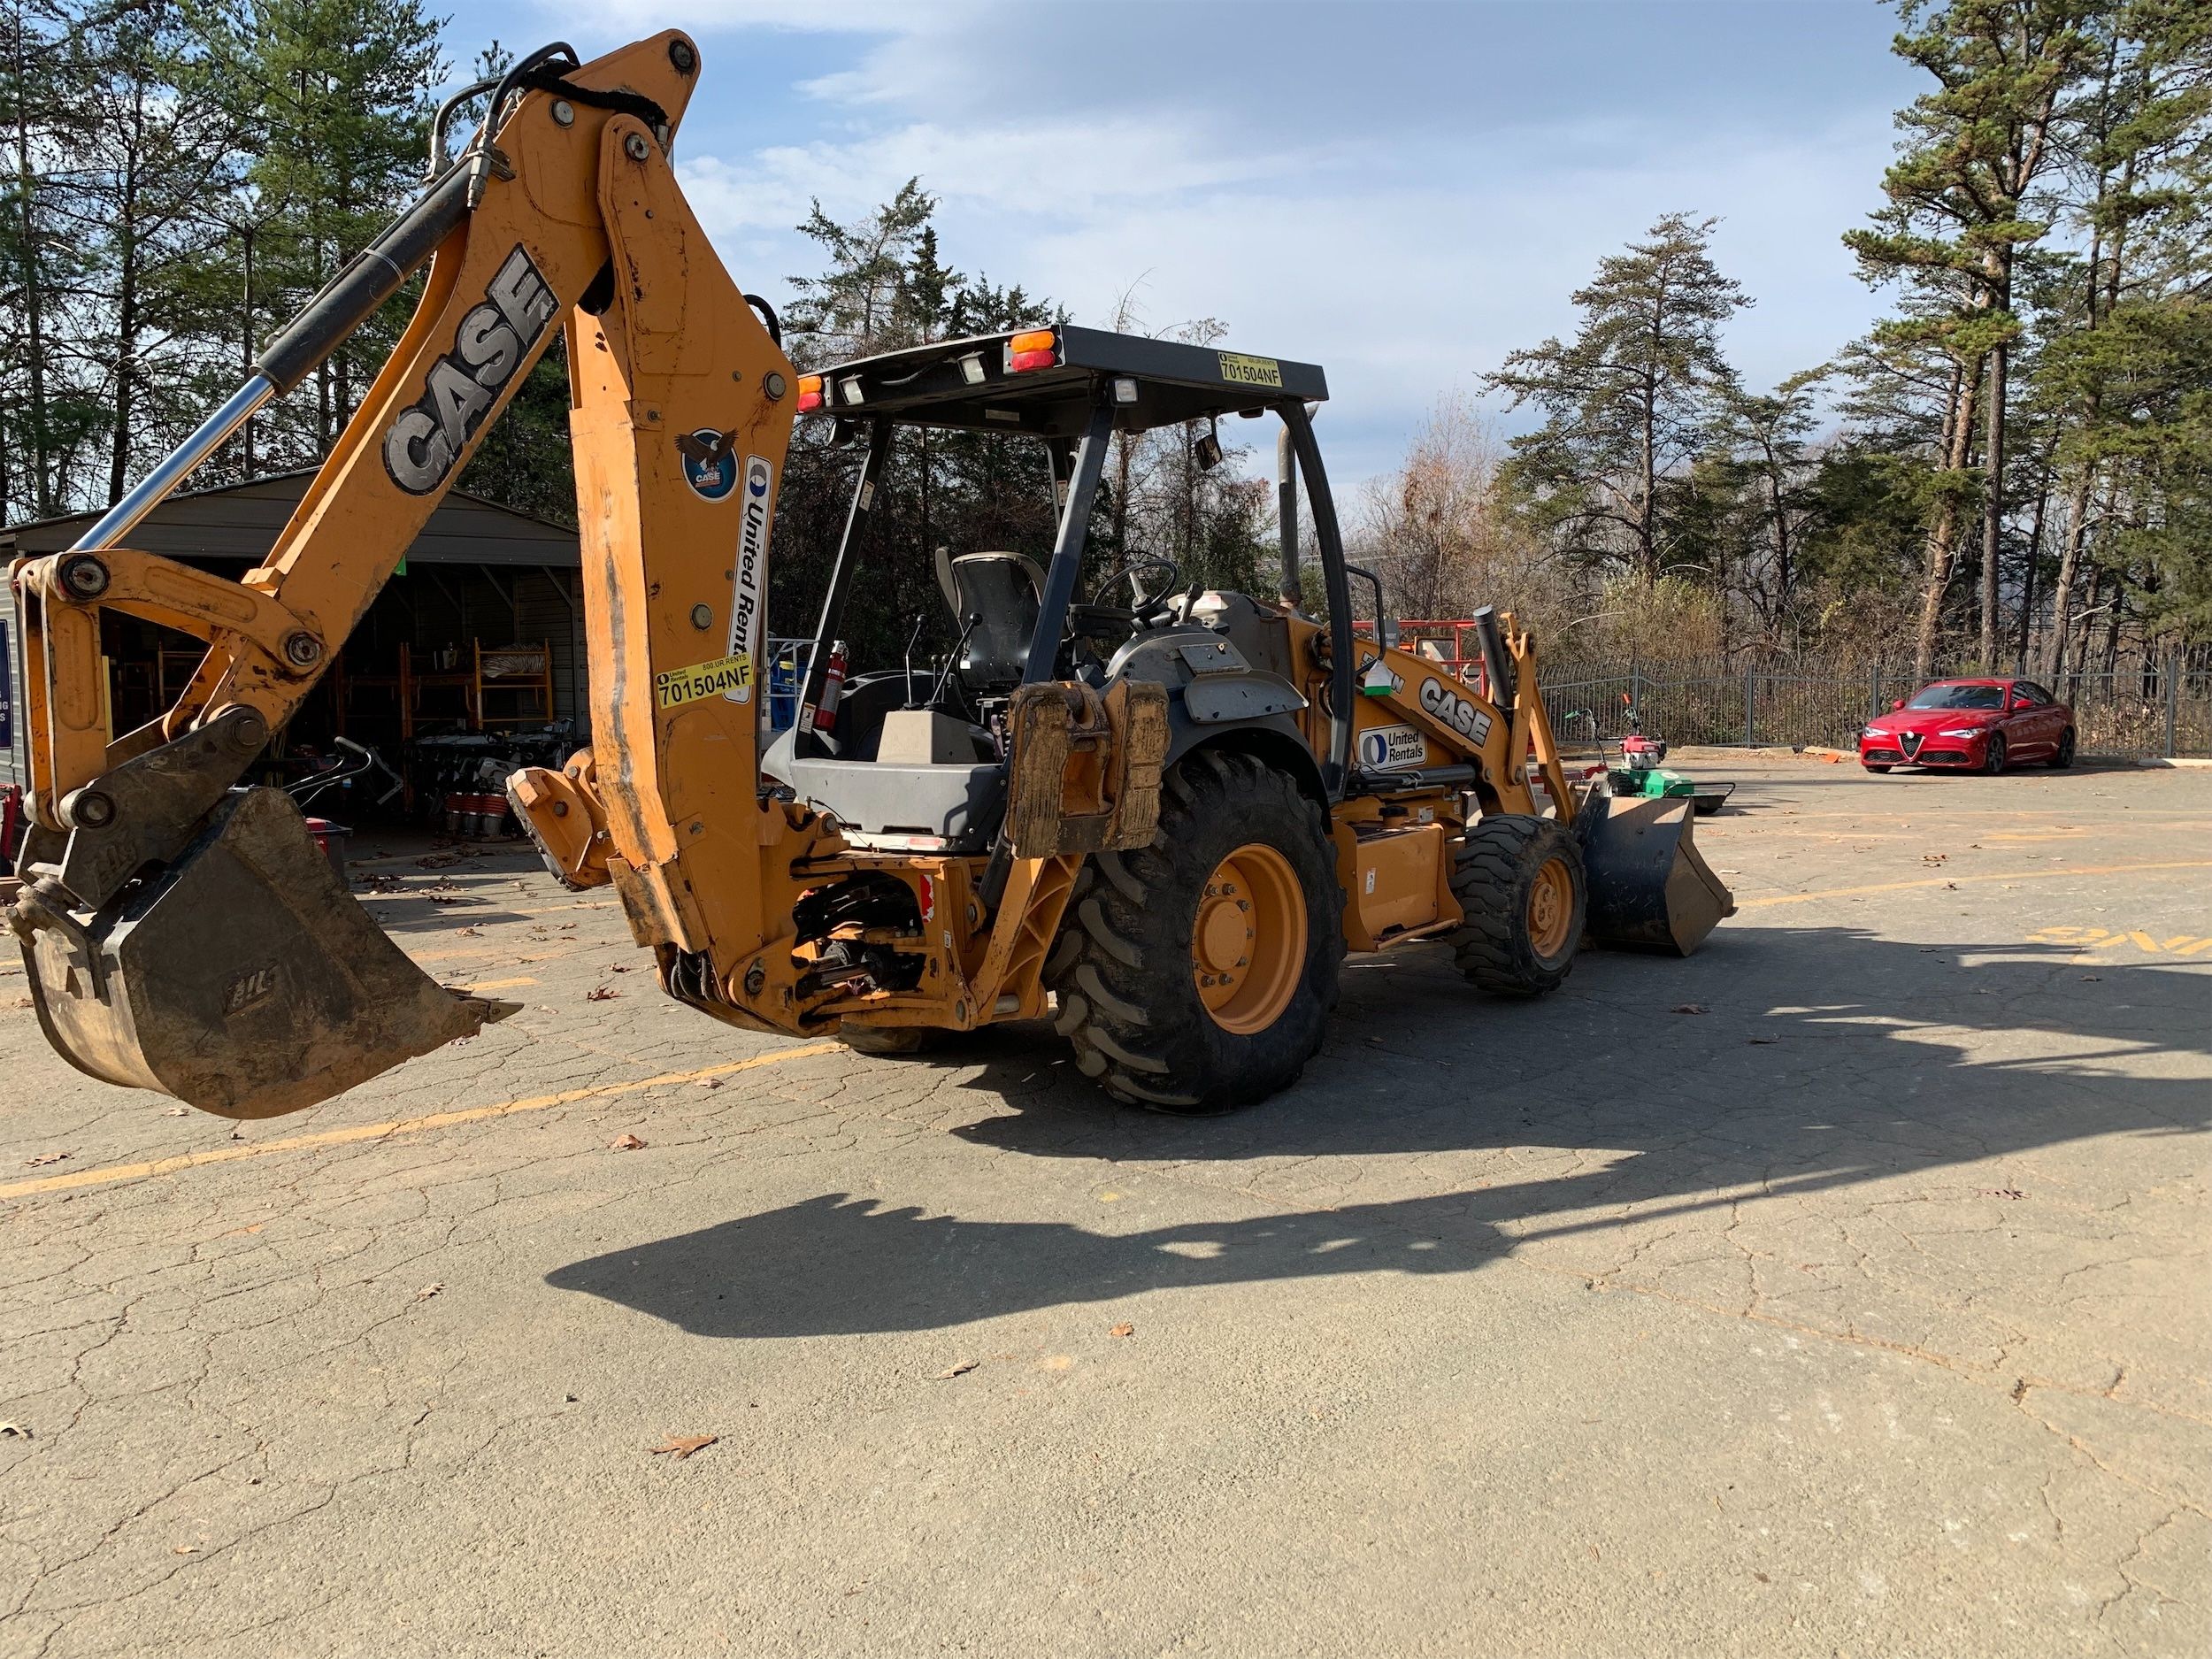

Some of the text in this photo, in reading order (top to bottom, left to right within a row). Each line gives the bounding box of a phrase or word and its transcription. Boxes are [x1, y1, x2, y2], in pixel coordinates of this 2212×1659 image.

[382, 242, 561, 496] CASE
[1221, 363, 1279, 384] 701504NF
[695, 472, 721, 483] CASE
[733, 502, 764, 656] United Rent
[703, 654, 747, 671] 800.UR.RENTS
[658, 664, 749, 705] 701504NF
[1419, 677, 1493, 749] CASE
[1388, 732, 1419, 747] United
[1389, 747, 1423, 762] Rentals
